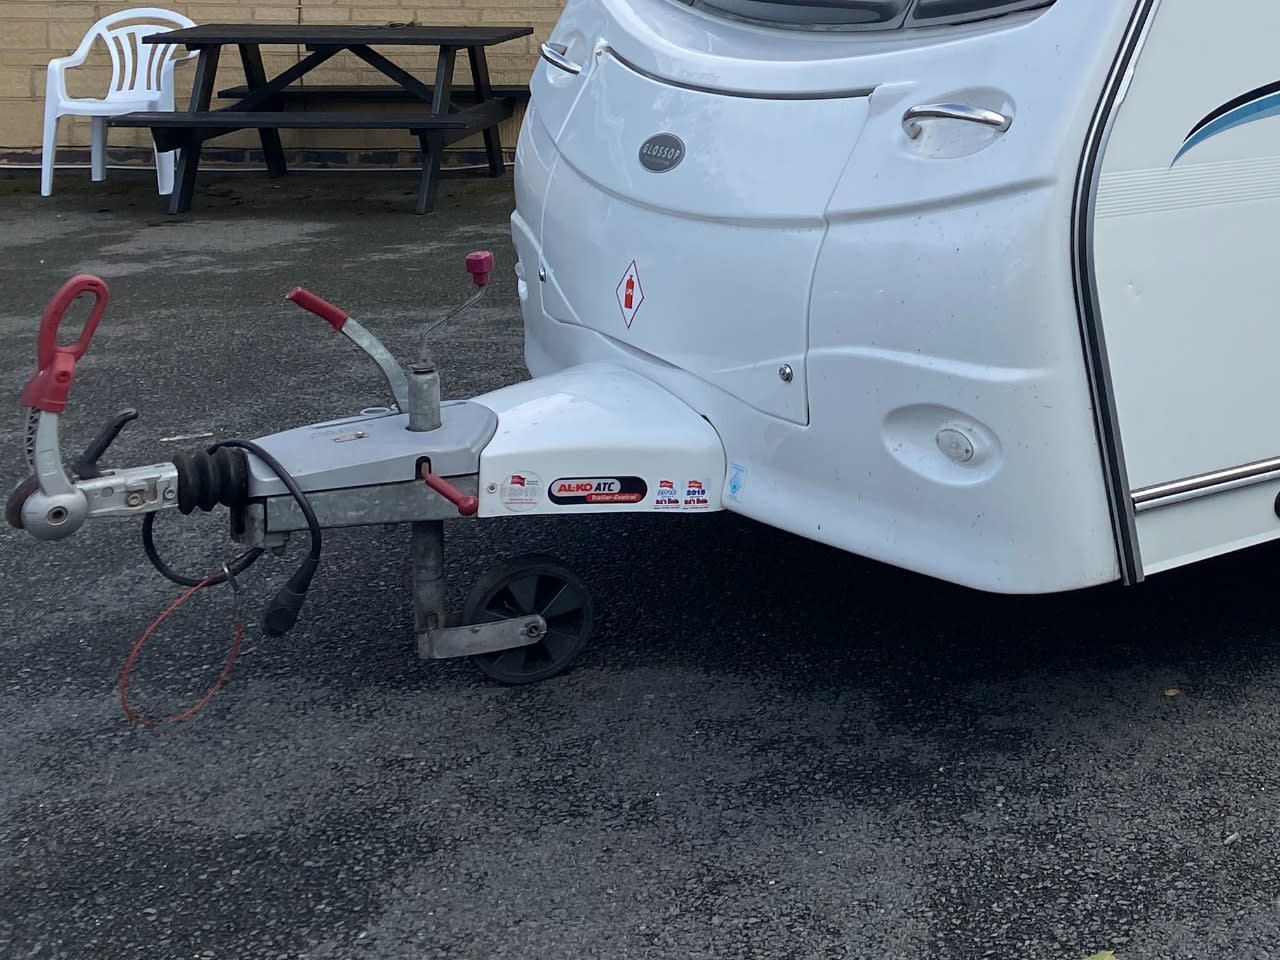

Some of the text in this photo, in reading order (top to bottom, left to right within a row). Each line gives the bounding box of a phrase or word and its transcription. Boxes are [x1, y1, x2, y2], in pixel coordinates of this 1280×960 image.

[642, 143, 681, 160] GLOSSOP
[557, 482, 615, 493] AL-KO ATC
